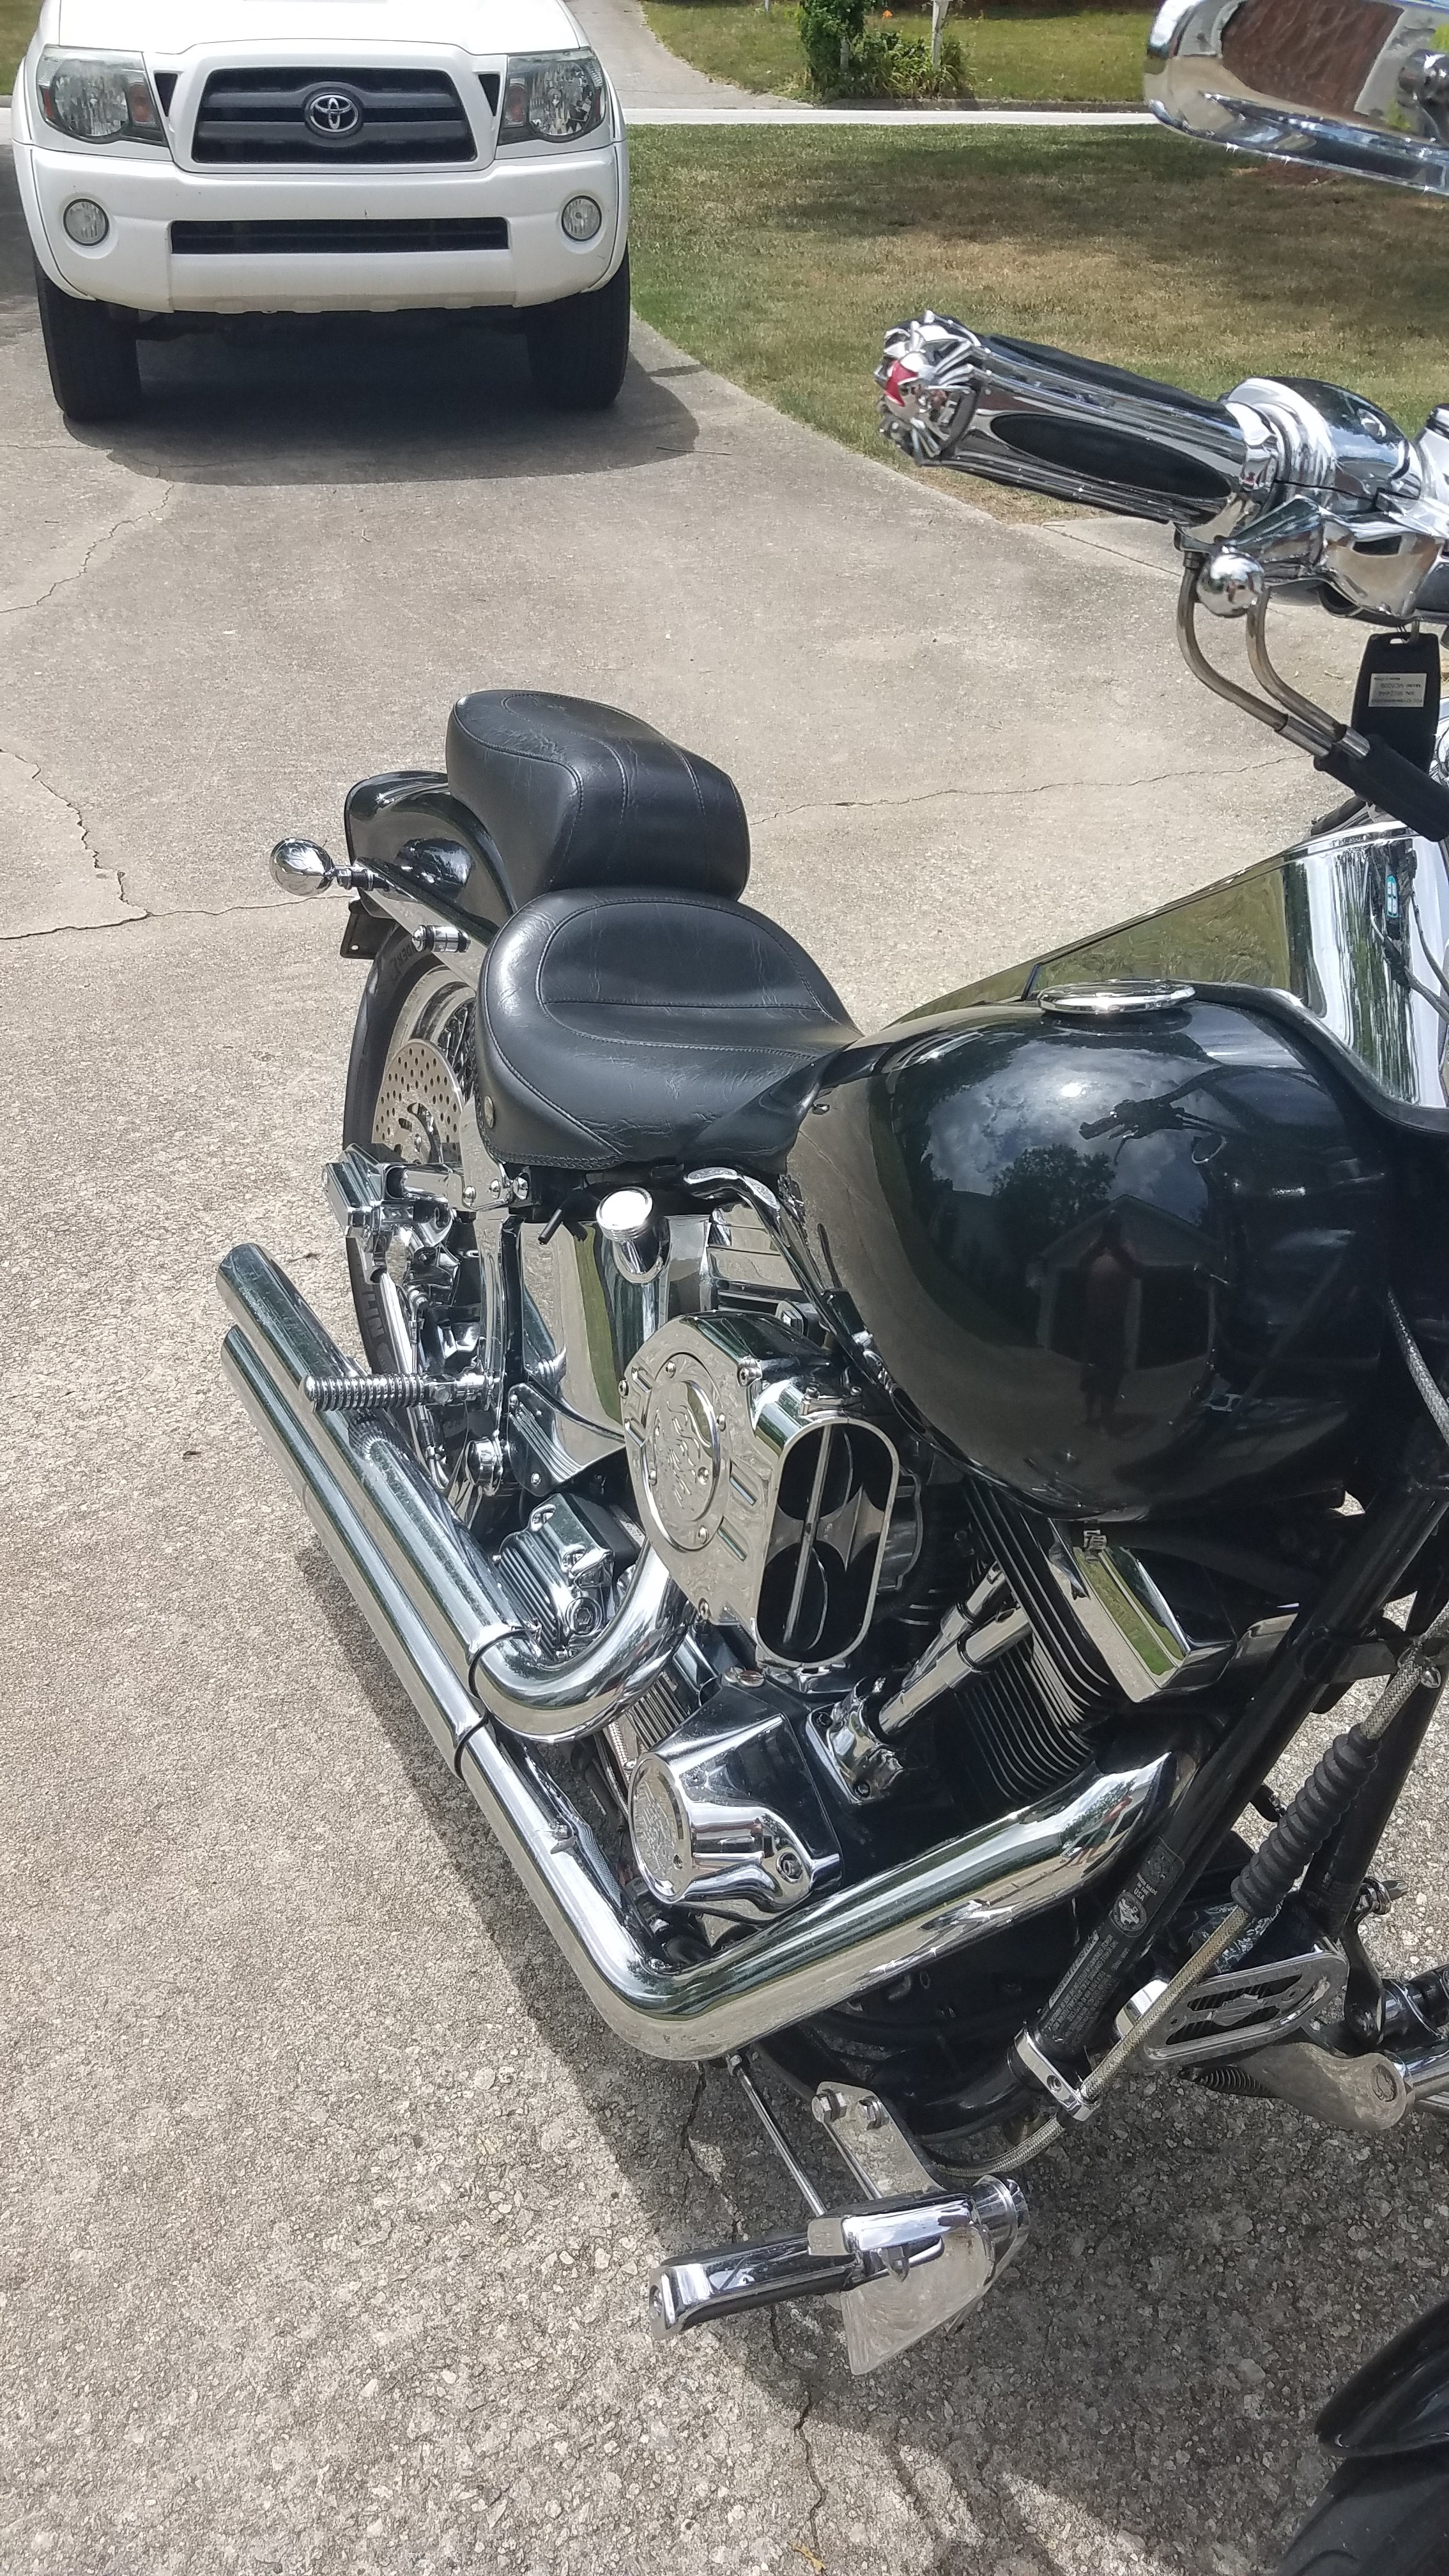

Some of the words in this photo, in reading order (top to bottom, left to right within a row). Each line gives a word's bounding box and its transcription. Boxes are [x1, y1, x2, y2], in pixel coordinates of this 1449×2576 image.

[1134, 1887, 1145, 1901] USA
[1141, 1887, 1149, 1896] THE
[1146, 1883, 1158, 1896] MADE
